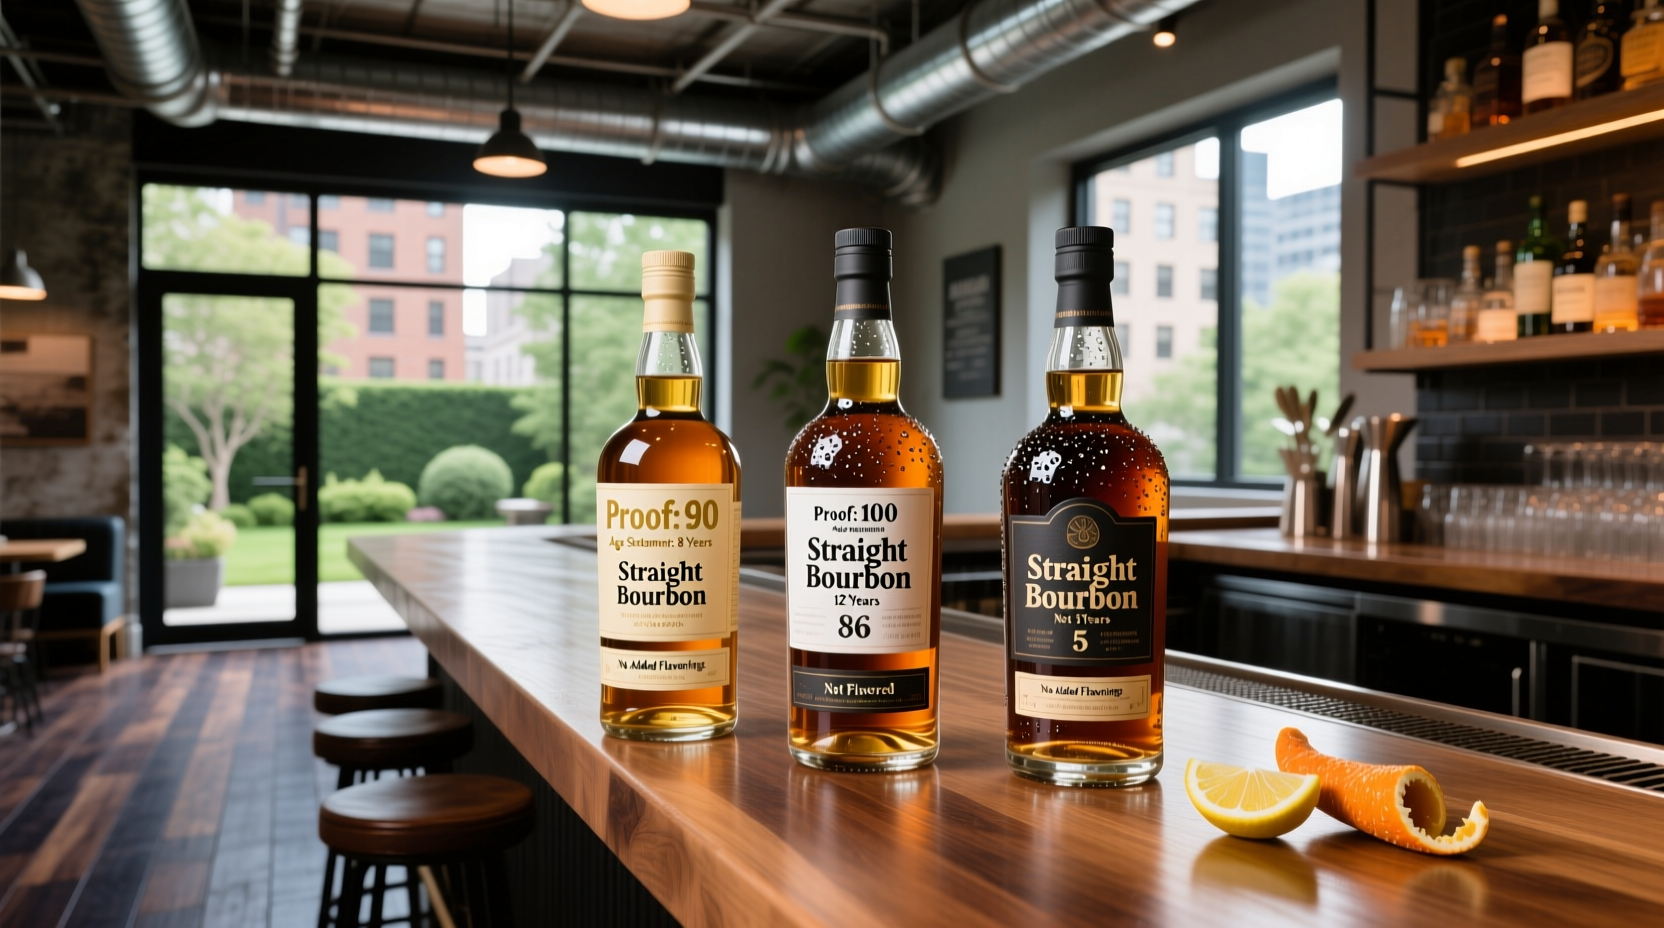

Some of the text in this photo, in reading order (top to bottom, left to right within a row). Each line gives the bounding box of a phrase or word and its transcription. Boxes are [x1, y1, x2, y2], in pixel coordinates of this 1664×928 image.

[607, 499, 719, 531] Proof: 90
[814, 502, 898, 523] Proof: 100
[677, 537, 684, 548] 8
[808, 536, 908, 569] Straight
[618, 560, 704, 588] Straight
[806, 563, 912, 590] Bourbon
[1027, 553, 1138, 589] Straight
[617, 582, 707, 606] Bourbon
[834, 593, 881, 607] 12 Years
[1025, 583, 1139, 610] Bourbon
[838, 614, 871, 639] 86
[1072, 629, 1089, 653] 5
[824, 681, 844, 696] Not
